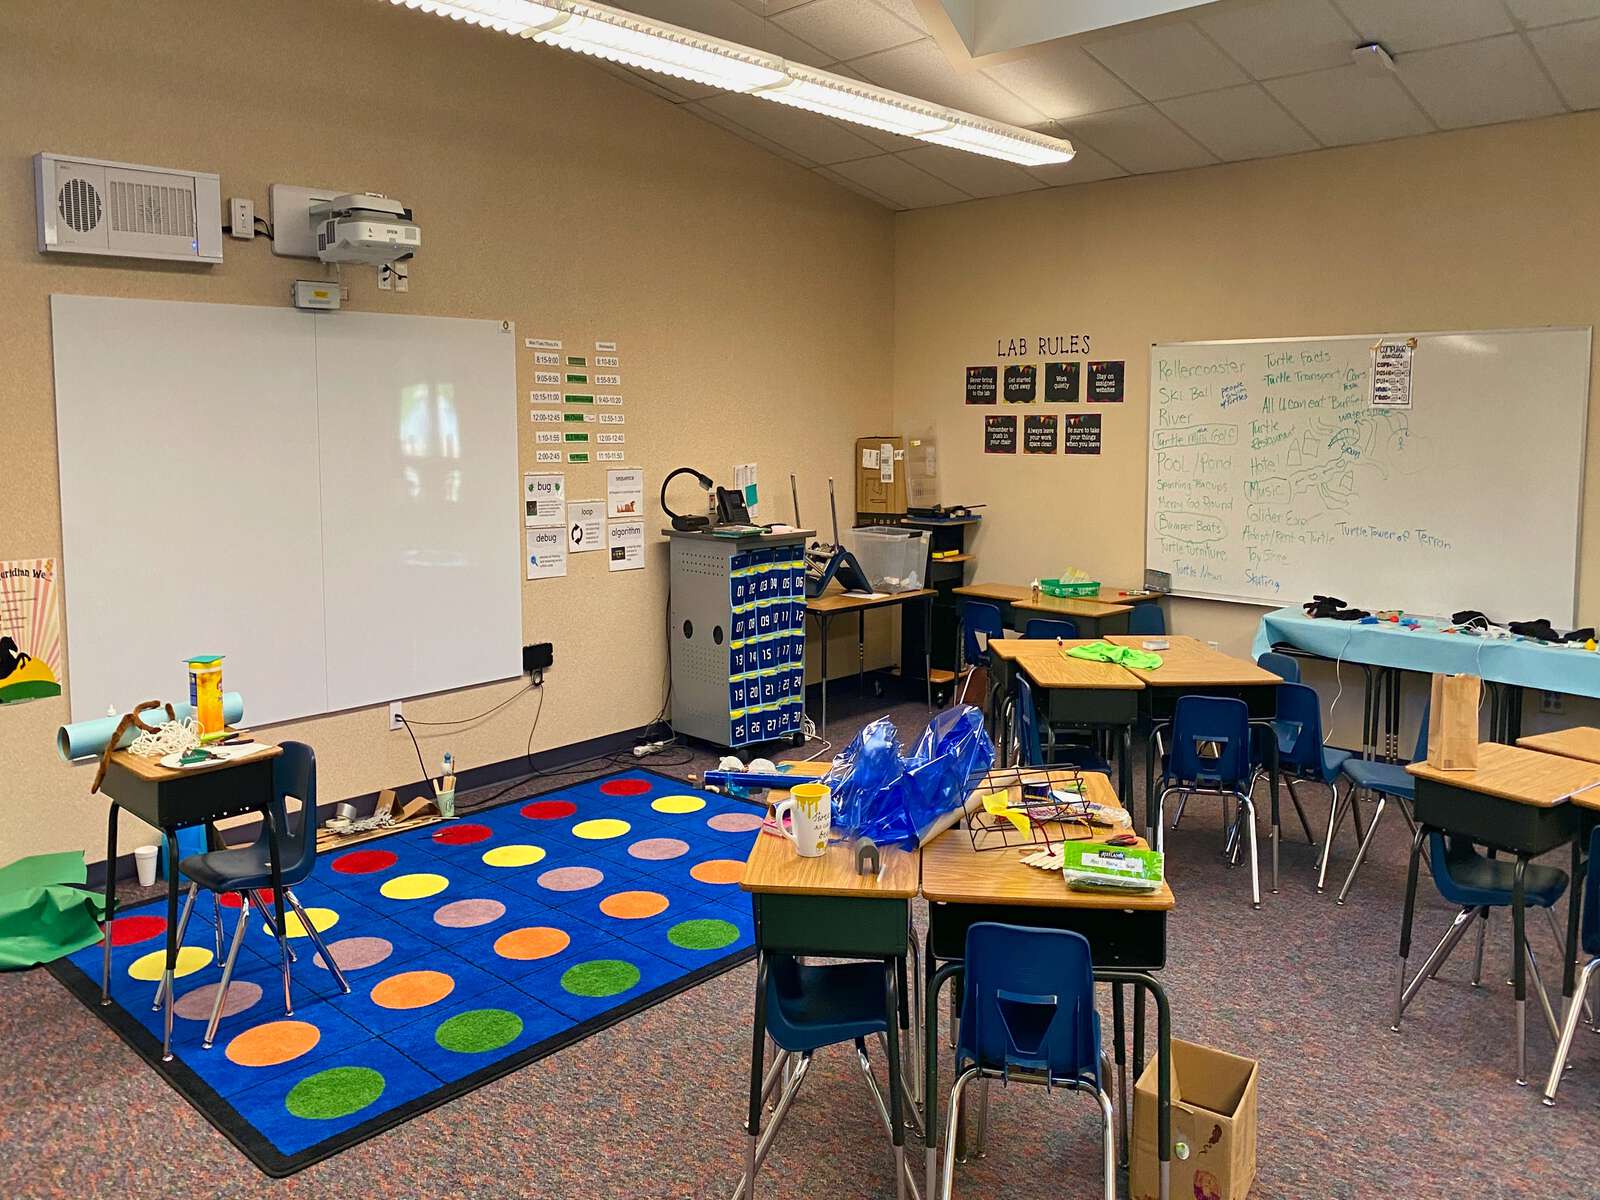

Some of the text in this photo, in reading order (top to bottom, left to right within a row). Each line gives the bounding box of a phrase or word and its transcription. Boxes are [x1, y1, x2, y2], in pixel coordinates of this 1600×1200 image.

[998, 335, 1090, 356] LAB RULES
[1264, 352, 1294, 368] Turtle
[1264, 372, 1290, 386] Turtle
[1190, 384, 1212, 400] Ball
[1263, 396, 1274, 412] All
[1159, 408, 1191, 425] River
[1248, 420, 1279, 436] Turtle
[1157, 432, 1183, 446] Turtle
[537, 481, 552, 493] bug
[1249, 481, 1284, 496] Music
[1160, 513, 1221, 534] Bumper Boats
[612, 526, 640, 538] algorithm
[1306, 530, 1335, 544] Turtle
[1336, 522, 1367, 537] Turtle
[1368, 526, 1395, 540] Tower
[536, 534, 557, 544] debug
[1246, 547, 1261, 569] Toy
[0, 568, 30, 579] eridian
[749, 582, 756, 594] 02
[760, 580, 767, 591] 03
[782, 578, 790, 588] 05
[796, 577, 803, 588] 06
[737, 586, 744, 597] 01
[761, 615, 769, 626] 09
[782, 611, 788, 621] 11
[796, 610, 803, 621] 12
[736, 621, 743, 632] 07
[763, 648, 772, 660] 15
[782, 645, 789, 655] 17
[795, 644, 802, 655] 18
[736, 654, 742, 666] 13
[794, 676, 801, 687] 24
[735, 689, 743, 701] 19
[750, 686, 758, 698] 20
[765, 684, 774, 695] 21
[793, 712, 800, 722] 30
[735, 725, 744, 737] 25
[751, 722, 760, 733] 26
[767, 720, 776, 731] 27
